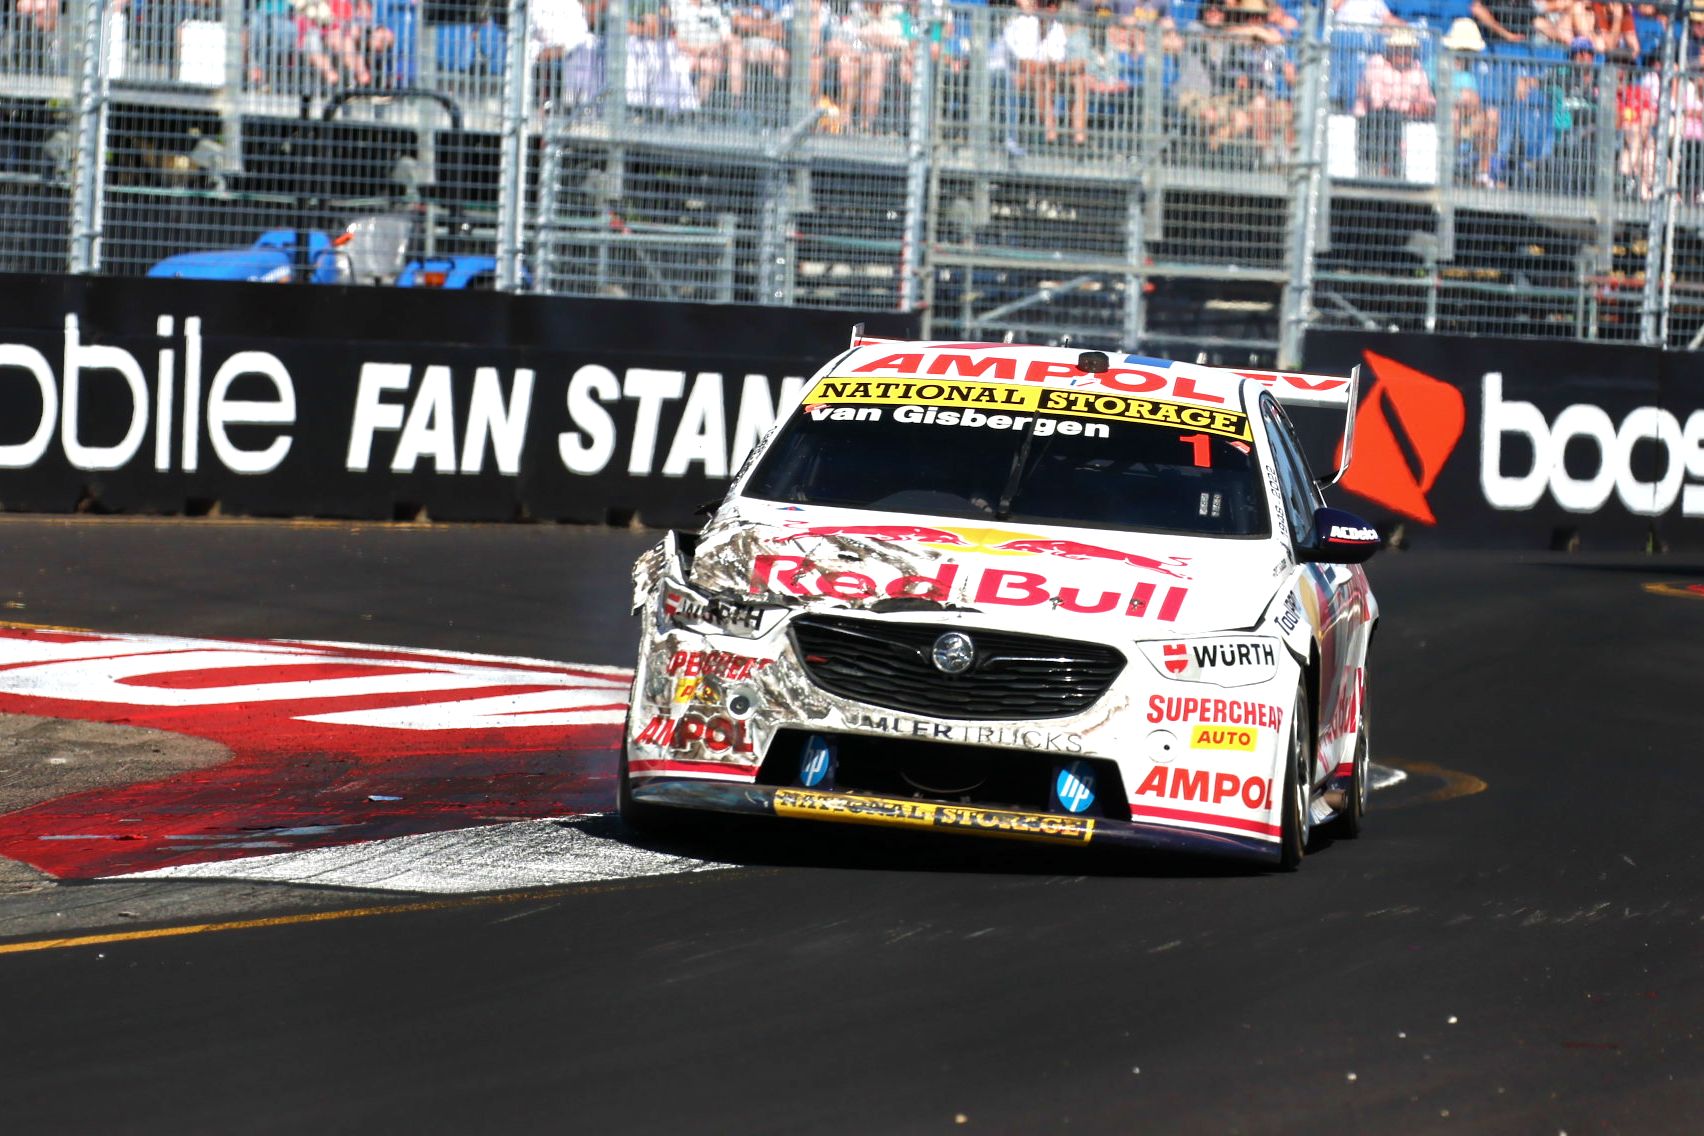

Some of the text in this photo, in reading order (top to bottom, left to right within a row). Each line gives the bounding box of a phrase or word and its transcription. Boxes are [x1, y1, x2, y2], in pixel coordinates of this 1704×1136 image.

[852, 352, 1225, 403] AMPOL
[347, 362, 535, 475] FAN
[810, 405, 1110, 438] van Gisbergen
[818, 382, 1237, 432] NATIONAL STORAGE
[1180, 434, 1210, 467] 1
[749, 555, 1188, 623] Red Bull
[1193, 643, 1275, 668] WÜRTH
[1147, 694, 1283, 734] SUPERCHEAP
[1197, 730, 1251, 746] AUTO
[1135, 765, 1273, 810] AMPOL
